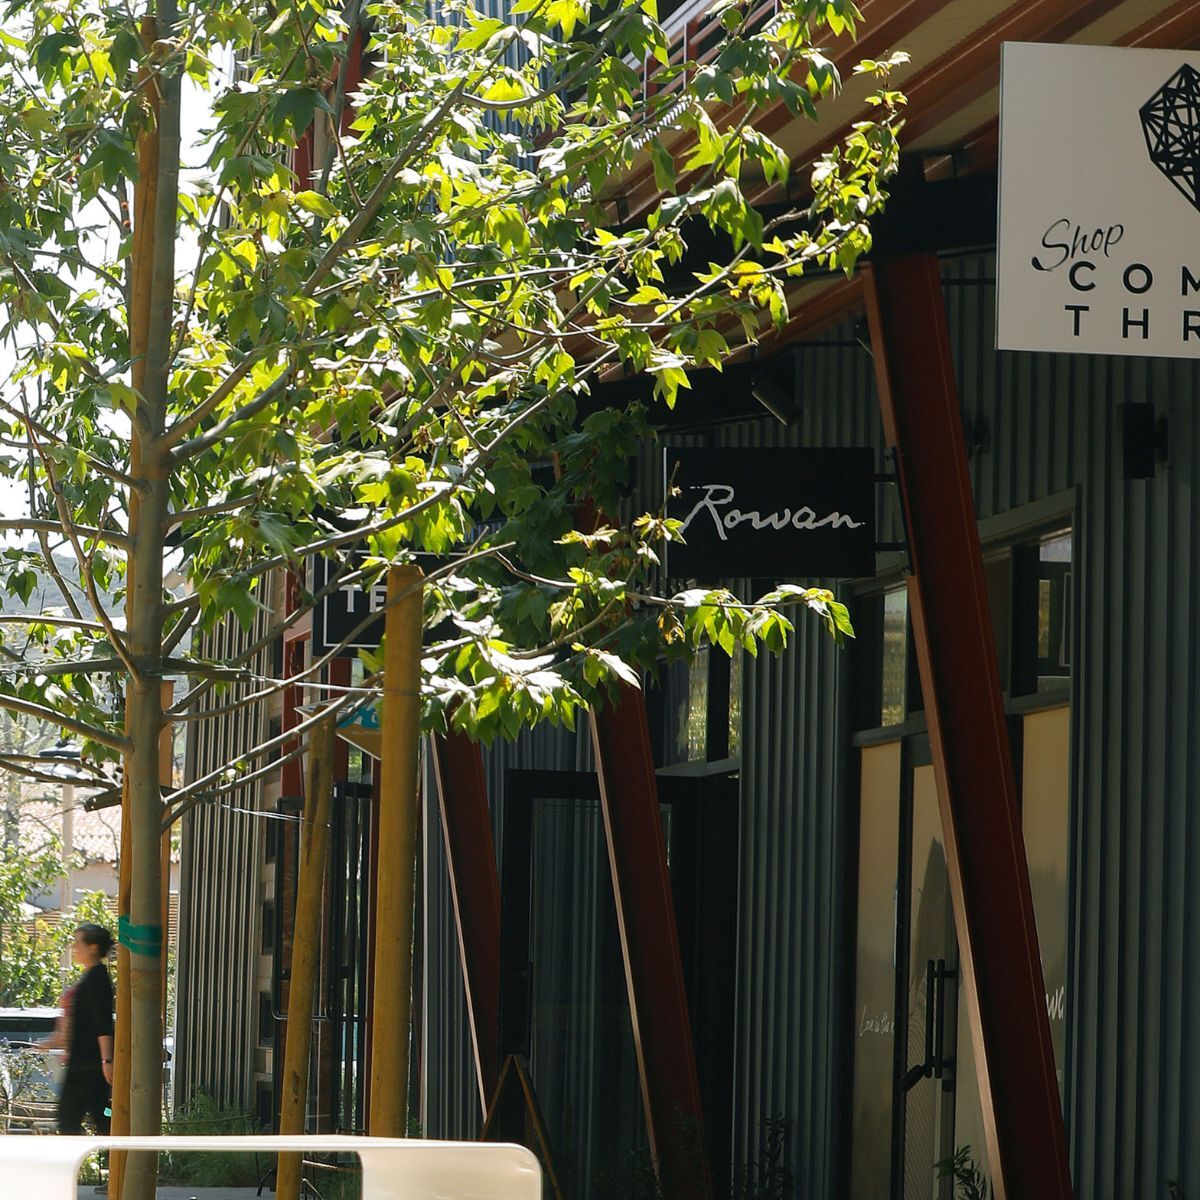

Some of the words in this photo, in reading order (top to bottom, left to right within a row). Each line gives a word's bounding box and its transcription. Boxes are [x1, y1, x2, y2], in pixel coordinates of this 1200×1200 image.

[1031, 218, 1124, 272] Shop
[1064, 304, 1200, 341] THR
[678, 484, 866, 541] Rowan
